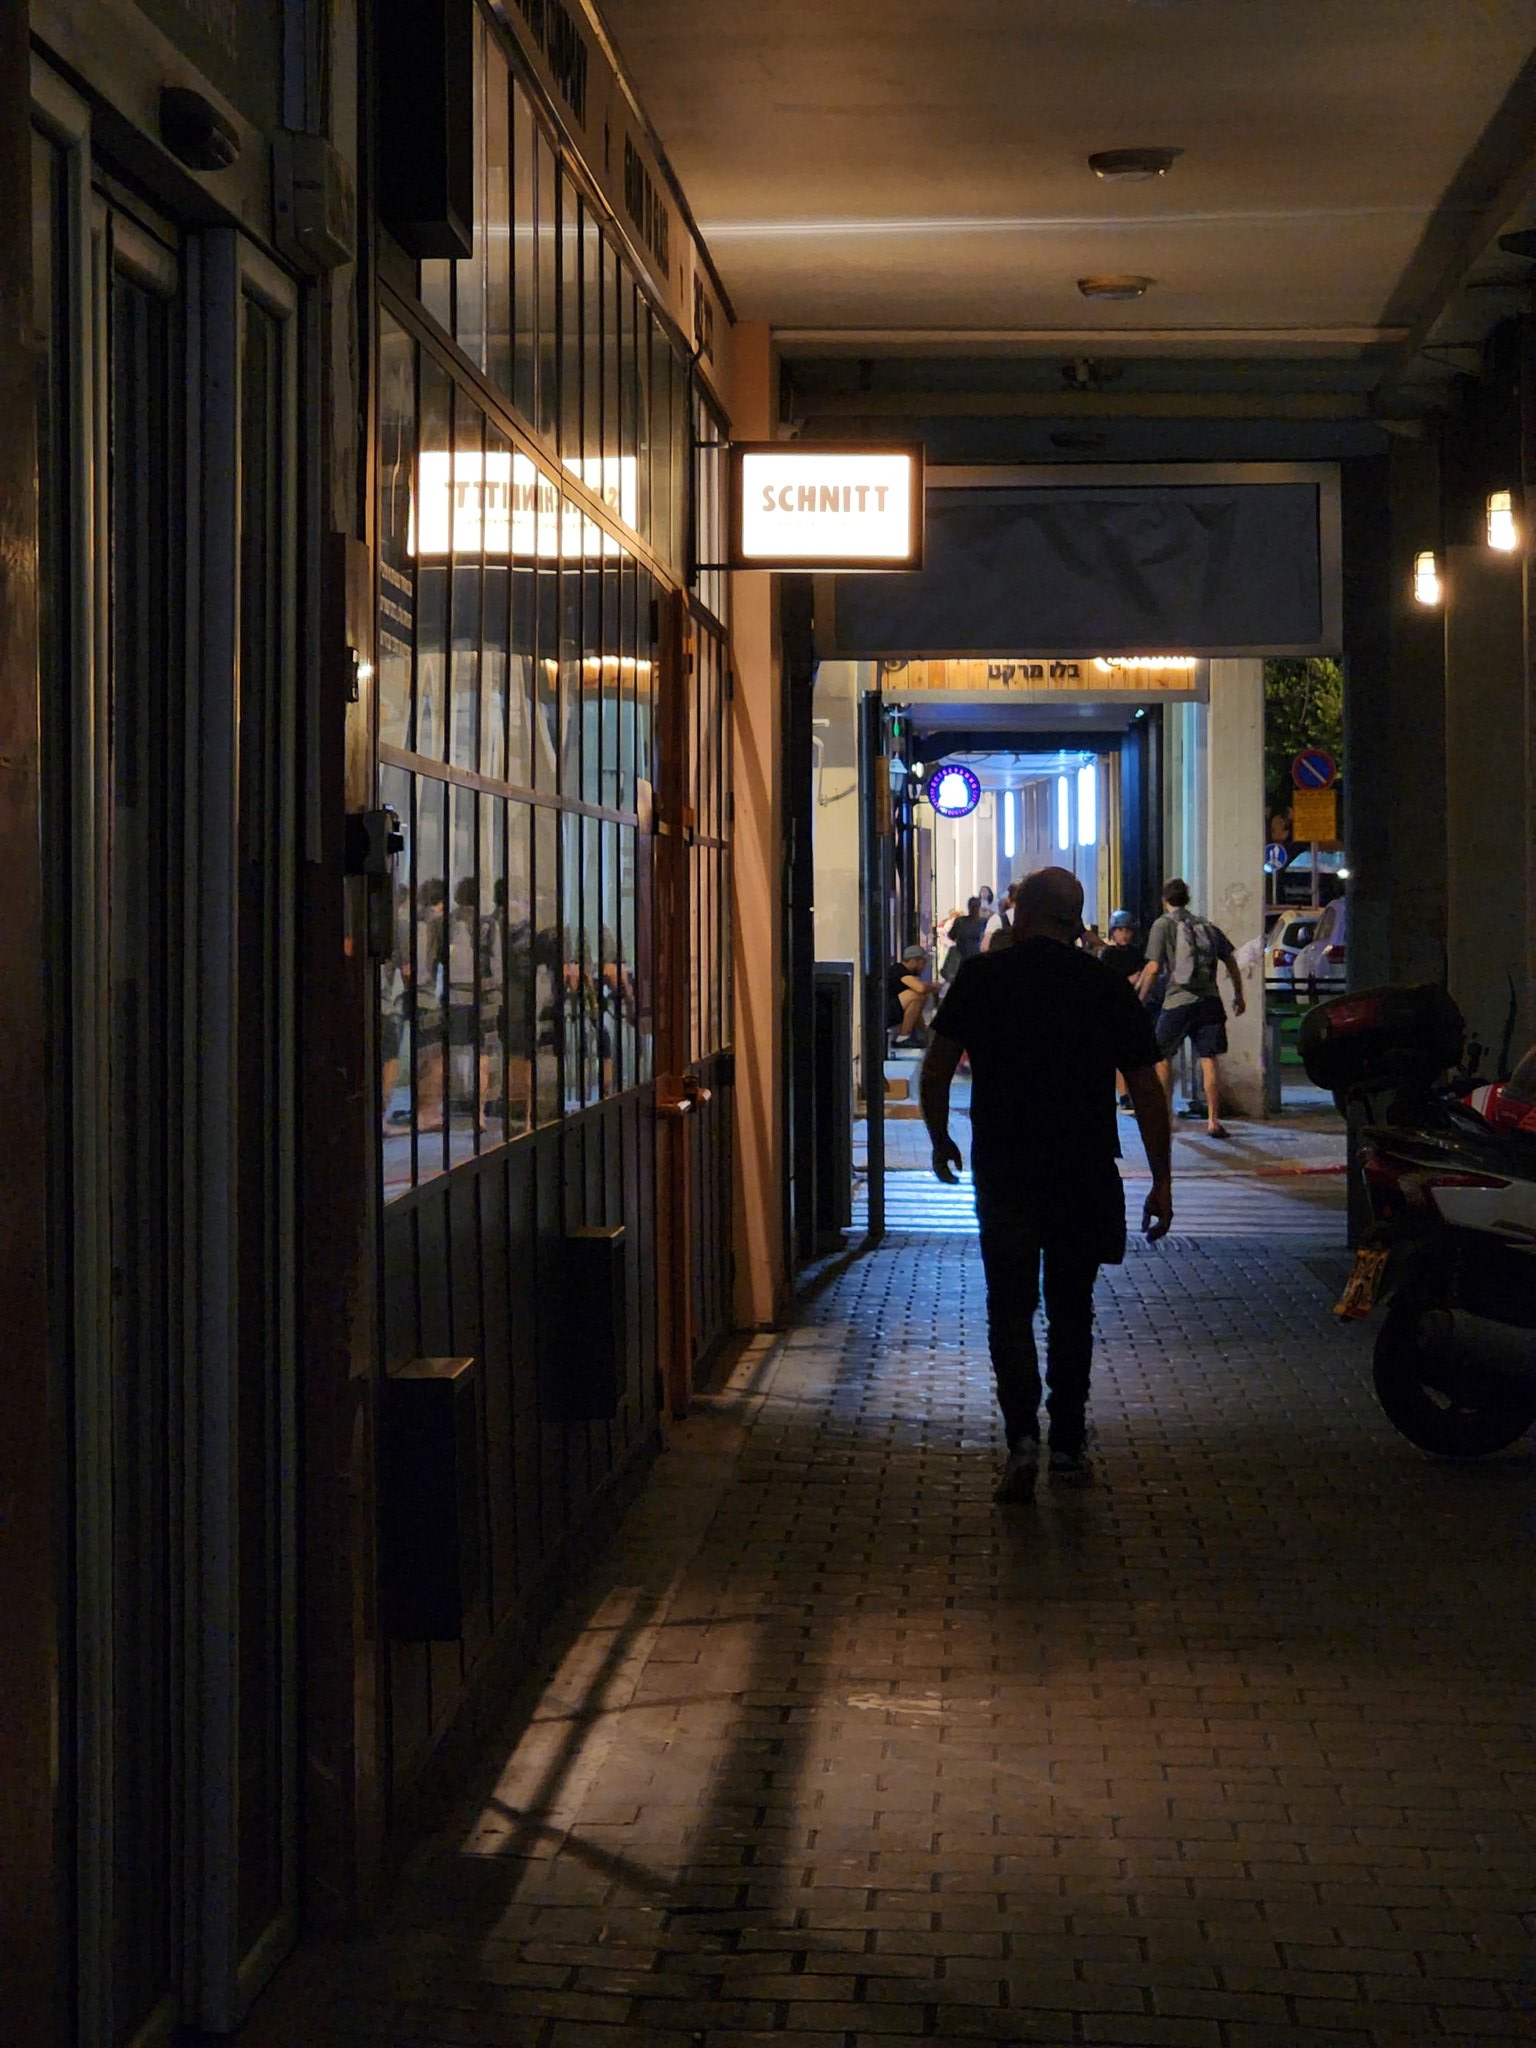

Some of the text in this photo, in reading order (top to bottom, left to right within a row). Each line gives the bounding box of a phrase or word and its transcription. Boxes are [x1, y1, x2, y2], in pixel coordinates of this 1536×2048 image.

[762, 484, 889, 513] SCHNITT
[988, 663, 1043, 685] מרקט
[1049, 660, 1080, 679] בלו
